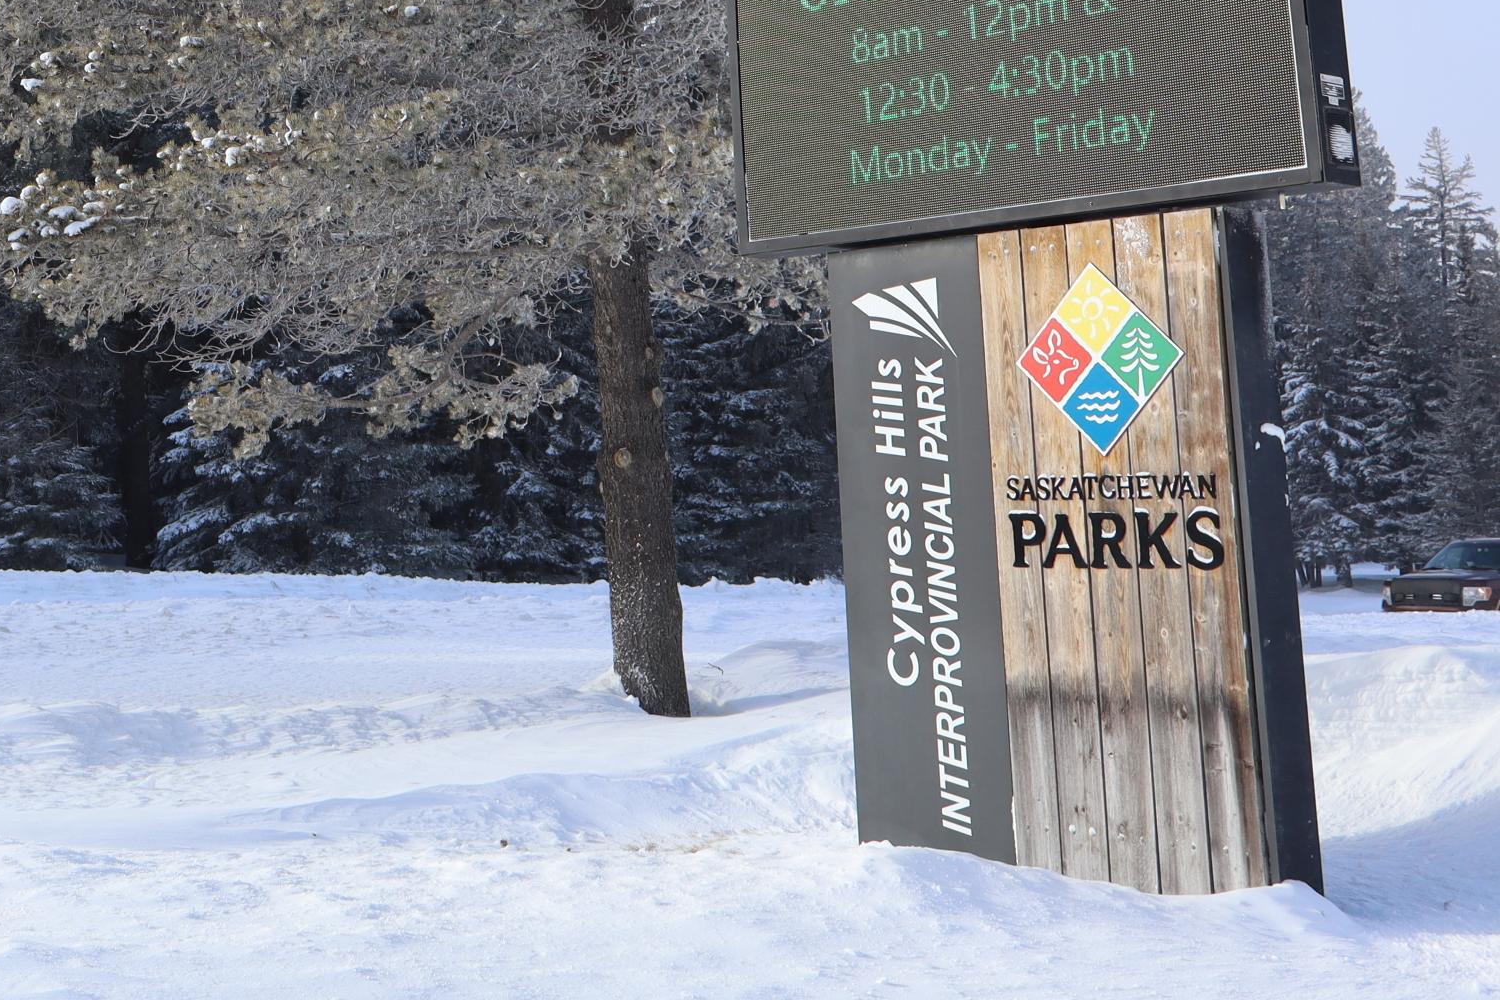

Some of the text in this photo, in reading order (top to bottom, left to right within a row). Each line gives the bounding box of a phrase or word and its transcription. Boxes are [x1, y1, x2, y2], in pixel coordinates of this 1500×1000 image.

[851, 27, 925, 65] 8am
[859, 72, 950, 124] 12:30
[988, 45, 1135, 97] 4:30pm
[850, 133, 992, 185] Monday
[1032, 106, 1156, 156] Friday
[871, 357, 925, 686] Cypress Hills
[1005, 472, 1217, 501] SASKATCHEWAN
[1008, 506, 1225, 570] PARKS
[916, 357, 972, 837] INTERPROVINCIAL PARK
